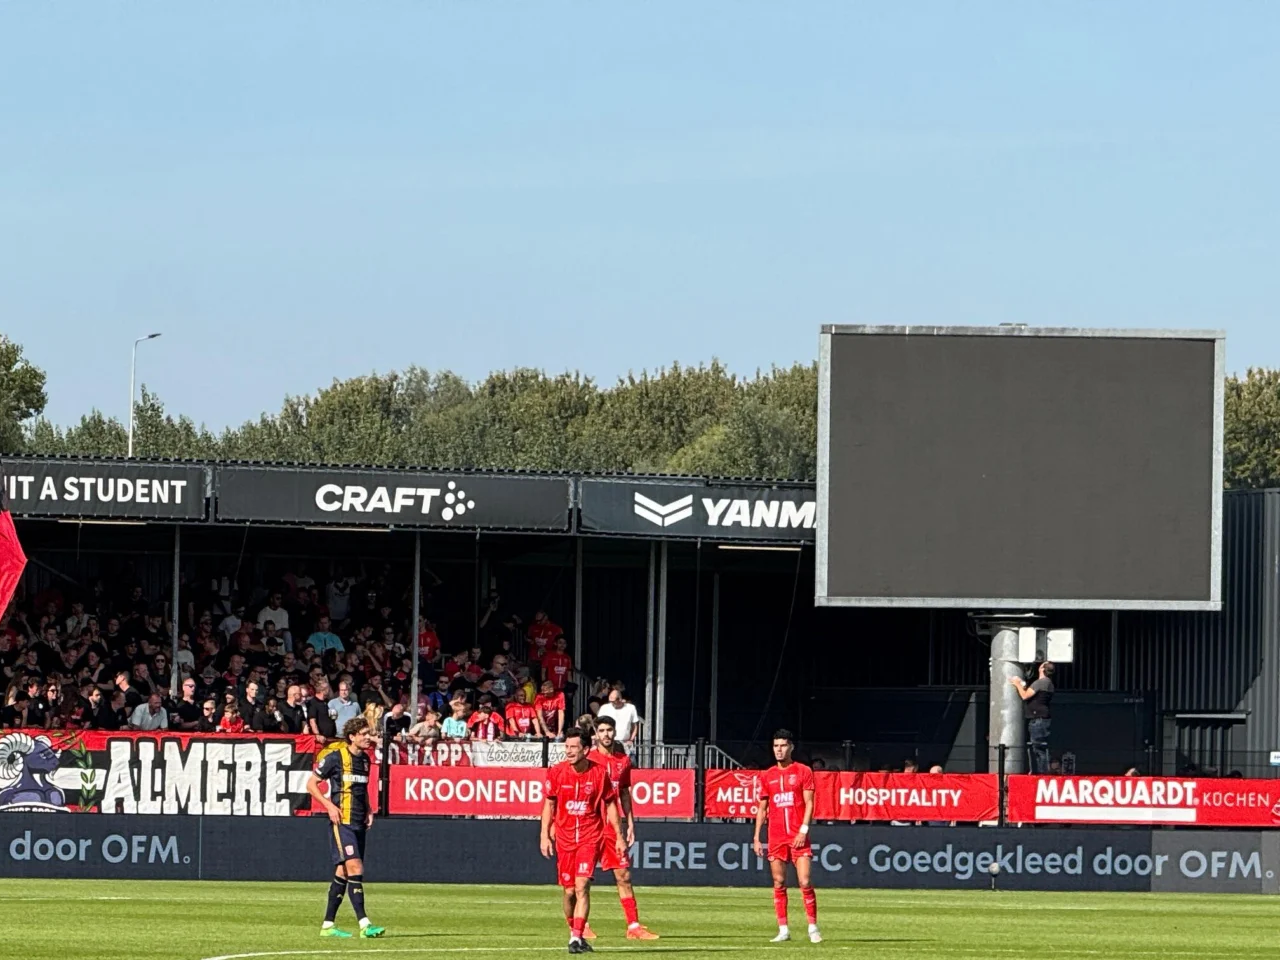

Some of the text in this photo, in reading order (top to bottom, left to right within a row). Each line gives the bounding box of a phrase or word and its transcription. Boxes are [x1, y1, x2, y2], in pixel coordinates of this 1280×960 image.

[39, 477, 58, 500] A
[63, 477, 187, 504] STUDENT
[315, 484, 440, 512] CRAFT
[702, 498, 817, 528] YANM
[101, 741, 293, 816] ALMERE
[405, 778, 681, 805] KROONENB OEP
[728, 805, 758, 815] GRO
[773, 792, 794, 803] ONE
[839, 787, 963, 807] HOSPITALITY
[9, 829, 91, 861] door
[717, 841, 769, 871] CIT
[869, 844, 1083, 880] Goedgekleed
[1093, 846, 1169, 877] door
